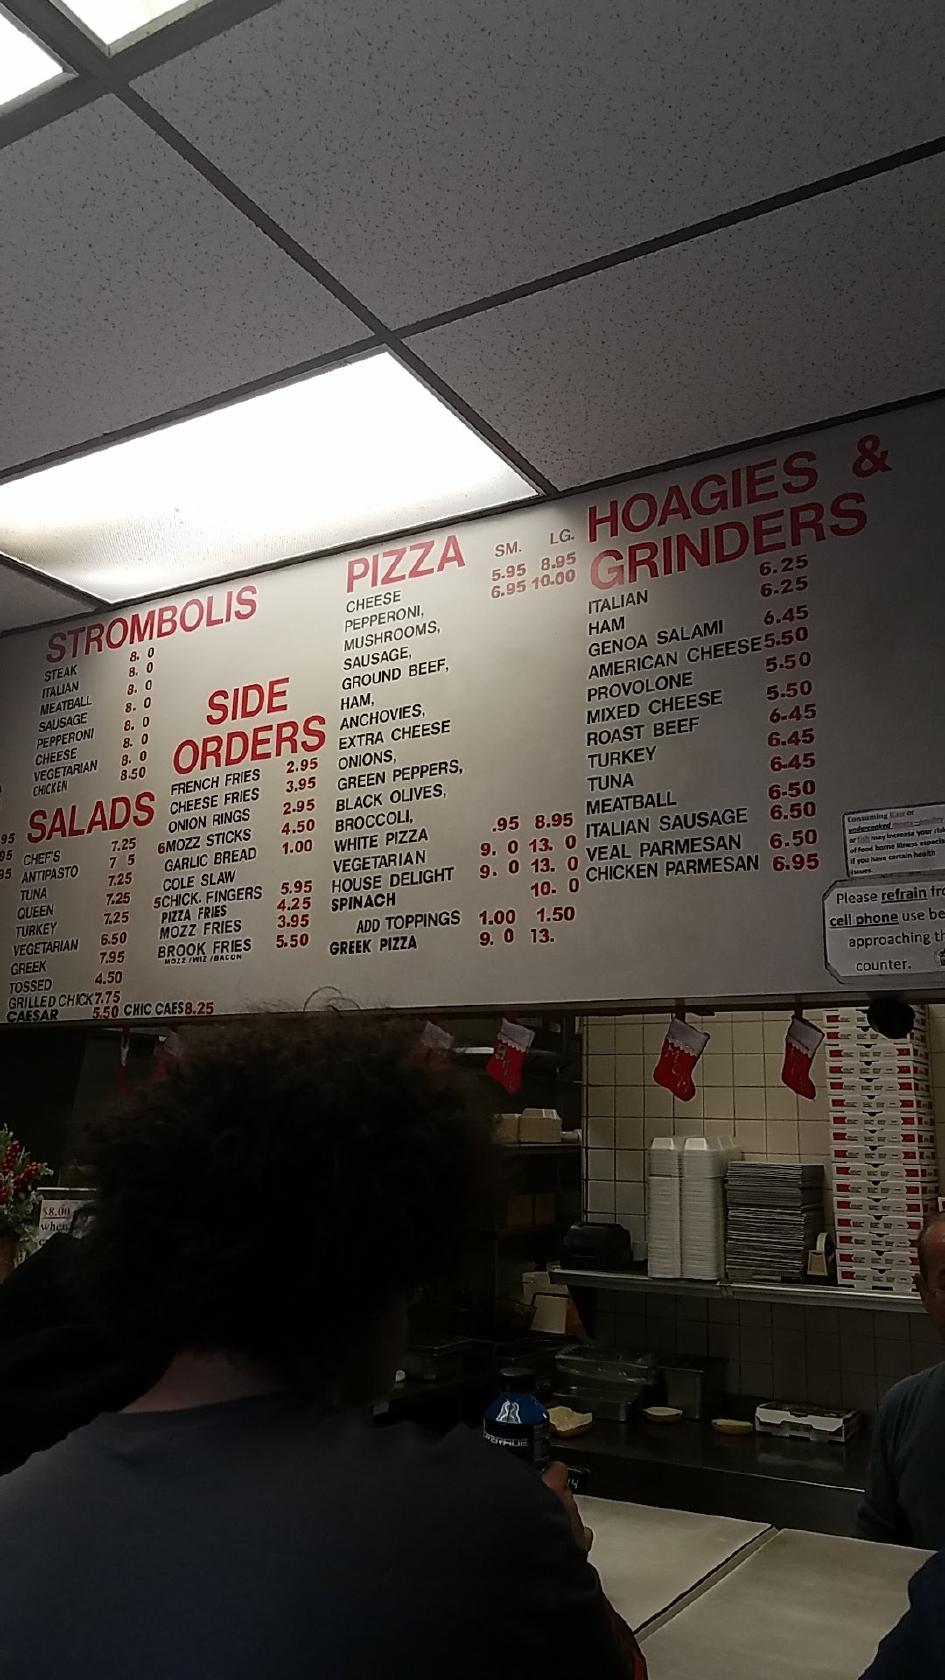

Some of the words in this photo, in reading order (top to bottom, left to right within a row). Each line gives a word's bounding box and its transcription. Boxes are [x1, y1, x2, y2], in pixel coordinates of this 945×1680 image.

[588, 451, 818, 543] HOAGIES
[852, 434, 893, 478] &
[495, 542, 522, 557] SM.
[550, 528, 574, 544] LG.
[590, 492, 867, 589] GRINDERS
[346, 535, 465, 593] PIZZA
[491, 563, 526, 581] 5.95
[541, 553, 576, 571] 8.95
[759, 555, 808, 576] 6.25
[491, 581, 526, 598] 6.95
[532, 570, 576, 590] 10.00
[760, 576, 808, 597] 6.25
[346, 591, 401, 613] CHEESE
[588, 590, 648, 614] ITALIAN
[46, 585, 258, 663] STROMBOLIS
[345, 605, 424, 632] PEPPERONI,
[764, 605, 809, 625] 6.45
[344, 621, 440, 651] MUSHROOMS,
[589, 617, 625, 636] HAM
[588, 636, 648, 656] GENOA
[657, 620, 724, 644] SALAMI
[343, 647, 411, 670] SAUSAGE,
[589, 652, 678, 679] AMERICAN
[687, 636, 762, 663] CHEESE
[764, 627, 808, 648] 5.50
[766, 652, 811, 672] 5.50
[44, 665, 78, 682] STEAK
[342, 668, 401, 690] GROUND
[409, 659, 449, 677] BEEF,
[42, 681, 79, 699] ITALIAN
[588, 672, 693, 701] PROVOLONE
[766, 680, 812, 700] 5.50
[40, 696, 92, 716] MEATBALL
[206, 677, 290, 725] SIDE
[341, 694, 374, 710] HAM,
[587, 703, 640, 724] MIXED
[648, 690, 722, 714] CHEESE
[38, 713, 87, 732] SAUSAGE
[340, 704, 425, 730] ANCHOVIES,
[770, 704, 817, 723] 6.45
[36, 729, 94, 749] PEPPERONI
[339, 731, 384, 750] EXTRA
[391, 720, 451, 742] CHEESE
[587, 725, 644, 746] ROAST
[654, 717, 700, 737] BEEF
[768, 728, 814, 747] 6.45
[173, 715, 326, 775] ORDERS
[35, 748, 77, 766] CHEESE
[286, 759, 318, 773] 2.95
[339, 750, 397, 770] ONIONS,
[588, 746, 657, 768] TURKEY
[770, 752, 815, 772] 6.45
[33, 761, 98, 782] VEGETARIAN
[337, 772, 386, 791] GREEN
[393, 760, 463, 781] PEPPERS,
[32, 781, 67, 796] CHICKEN
[120, 768, 146, 781] 8.50
[171, 772, 219, 795] FRENCH
[224, 769, 260, 786] FRIES
[286, 777, 316, 793] 3.95
[588, 773, 634, 791] TUNA
[768, 780, 816, 800] 6.50
[169, 793, 218, 815] CHEESE
[224, 788, 259, 805] FRIES
[283, 801, 315, 815] 2.95
[336, 793, 383, 812] BLACK
[390, 784, 446, 803] OLIVES,
[587, 792, 677, 815] MEATBALL
[27, 791, 155, 843] SALADS
[770, 801, 816, 820] 6.50
[168, 816, 206, 833] ONION
[212, 809, 250, 826] RINGS
[281, 820, 315, 835] 4.50
[335, 810, 413, 832] BROCCOLI,
[535, 813, 573, 829] 8.95
[586, 818, 649, 838] ITALIAN
[659, 808, 748, 831] SAUSAGE
[112, 838, 136, 852] 7.25
[206, 828, 251, 846] STICKS
[282, 840, 313, 854] 1.00
[334, 835, 378, 852] WHITE
[386, 829, 428, 846] PIZZA
[586, 845, 631, 861] VEAL
[640, 835, 741, 857] PARMESAN
[770, 829, 817, 849] 6.50
[23, 851, 61, 866] CHEF'S
[164, 853, 208, 872] GARLIC
[214, 848, 256, 865] BREAD
[333, 850, 426, 873] VEGETARIAN
[586, 863, 658, 882] CHICKEN
[665, 855, 759, 876] PARMESAN
[773, 853, 819, 871] 6.95
[21, 866, 79, 883] ANTIPASTO
[108, 872, 132, 886] 7.25
[163, 876, 194, 892] COLE
[201, 870, 236, 887] SLAW
[332, 876, 381, 893] HOUSE
[390, 867, 454, 887] DELIGHT
[20, 888, 47, 901] TUNA
[206, 886, 262, 902] FINGERS
[281, 881, 312, 894] 5.95
[836, 892, 878, 904] Please
[881, 887, 927, 901] refrain
[106, 893, 130, 905] 7.25
[277, 898, 311, 911] 4.25
[331, 893, 396, 912] SPINACH
[17, 905, 54, 920] QUEEN
[104, 912, 129, 925] 7.25
[161, 909, 191, 923] PIZZA
[198, 906, 227, 919] FRIES
[278, 915, 309, 928] 3.95
[356, 920, 380, 934] ADD
[386, 910, 460, 930] TOPPINGS
[479, 910, 515, 925] 1.00
[537, 907, 575, 922] 1.50
[830, 914, 851, 926] cell
[856, 913, 899, 925] phone
[902, 910, 924, 921] use
[16, 923, 57, 937] TURKEY
[101, 932, 127, 945] 6.50
[159, 924, 196, 939] MOZZ
[203, 920, 242, 935] FRIES
[13, 939, 79, 957] VEGETARIAN
[158, 943, 205, 958] BROOK
[213, 939, 251, 954] FRIES
[276, 934, 309, 948] 5.50
[329, 939, 372, 955] GREEK
[380, 936, 417, 951] PIZZA
[849, 931, 931, 949] approaching
[11, 961, 46, 975] GREEK
[100, 952, 125, 964] 7.95
[856, 960, 911, 971] counter.
[9, 979, 52, 993] TOSSED
[95, 972, 122, 984] 4.50
[9, 996, 56, 1009] GRILLED
[58, 993, 93, 1006] CHICK
[94, 992, 120, 1004] 7.75
[7, 1010, 58, 1022] CAESAR
[92, 1006, 118, 1019] 5.50
[124, 1004, 151, 1016] CHIC
[155, 1002, 184, 1015] CAES
[185, 1003, 214, 1015] 8.25
